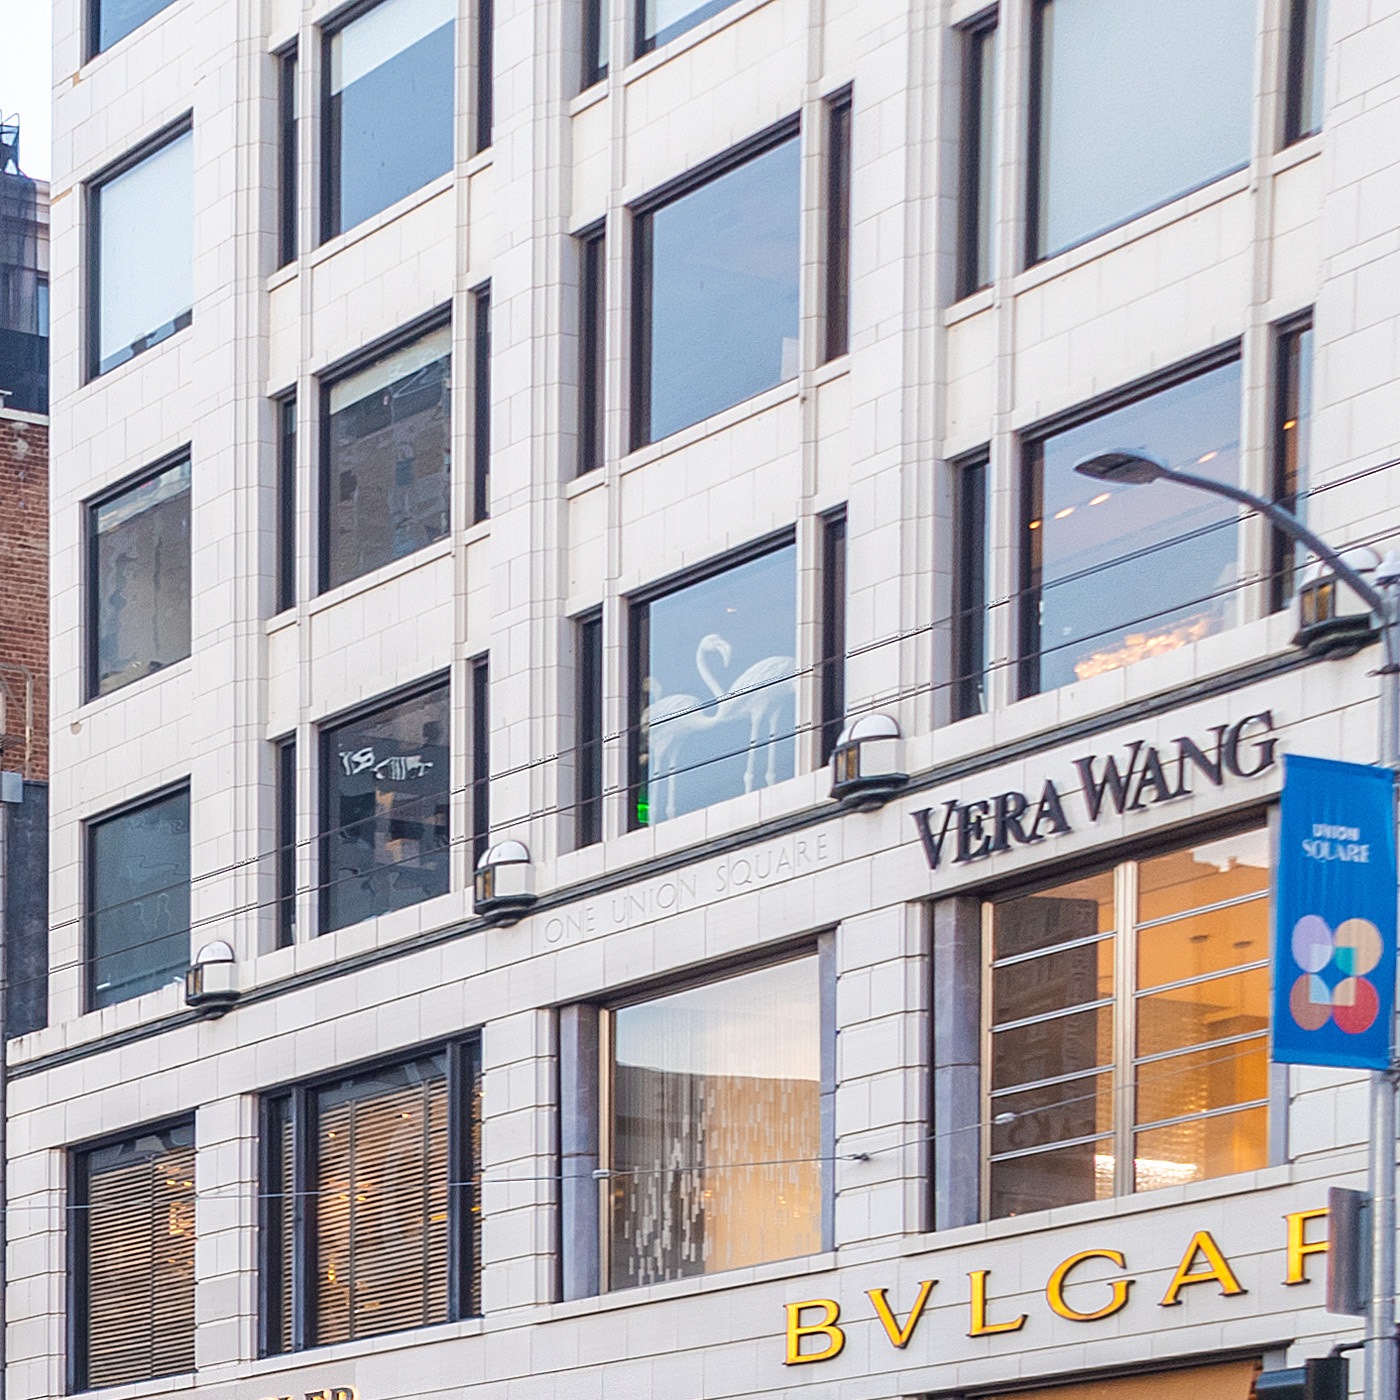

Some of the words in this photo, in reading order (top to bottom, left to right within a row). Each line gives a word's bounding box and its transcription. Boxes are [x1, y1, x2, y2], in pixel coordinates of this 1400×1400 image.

[909, 777, 1073, 870] VERA
[1073, 709, 1282, 823] WANG
[1302, 838, 1370, 863] SQUARE
[1312, 822, 1361, 842] UNION
[545, 906, 596, 944] ONE
[611, 874, 698, 925] UNION
[714, 833, 828, 893] SQUARE
